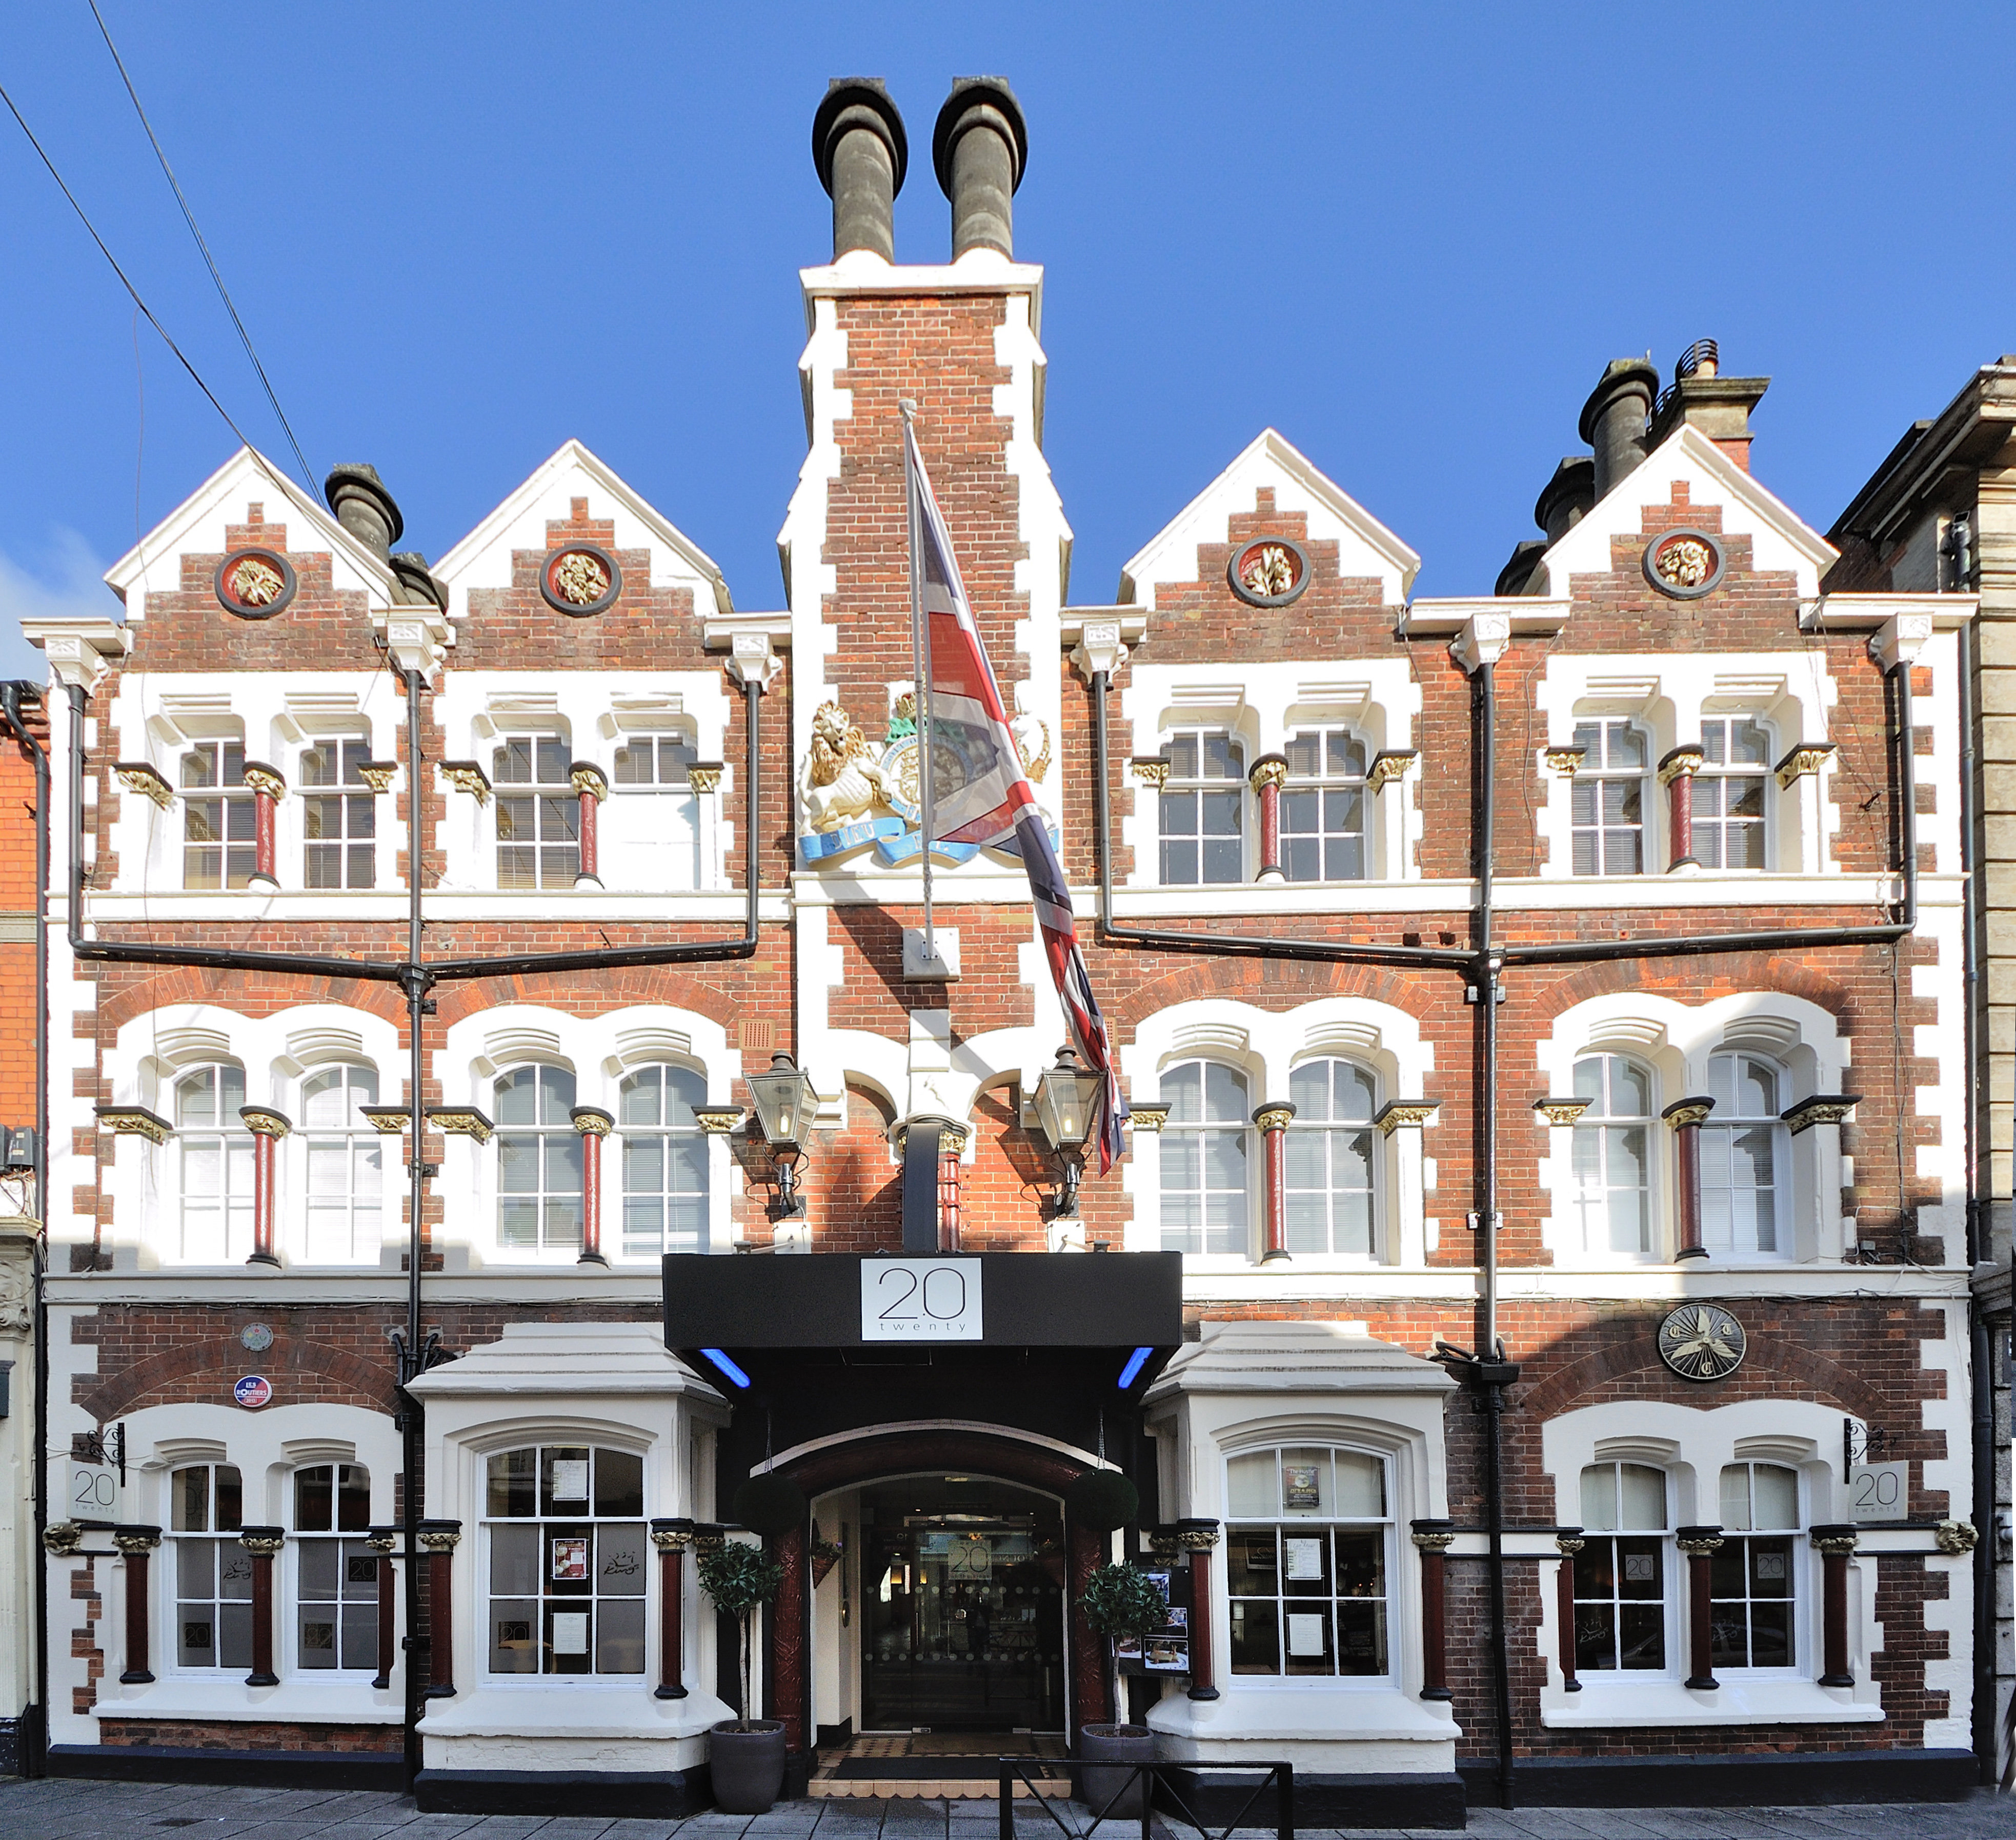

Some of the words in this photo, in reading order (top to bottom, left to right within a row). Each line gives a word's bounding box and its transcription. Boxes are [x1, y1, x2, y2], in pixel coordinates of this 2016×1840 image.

[830, 823, 875, 849] DIEU
[880, 1322, 965, 1332] twenty
[75, 1471, 114, 1506] 20
[1856, 1472, 1898, 1506] 20
[76, 1504, 114, 1514] twenty
[951, 1546, 988, 1572] 20
[1627, 1558, 1651, 1575] 20
[1760, 1557, 1782, 1574] 20
[351, 1561, 375, 1577] 20
[184, 1627, 208, 1643] 20
